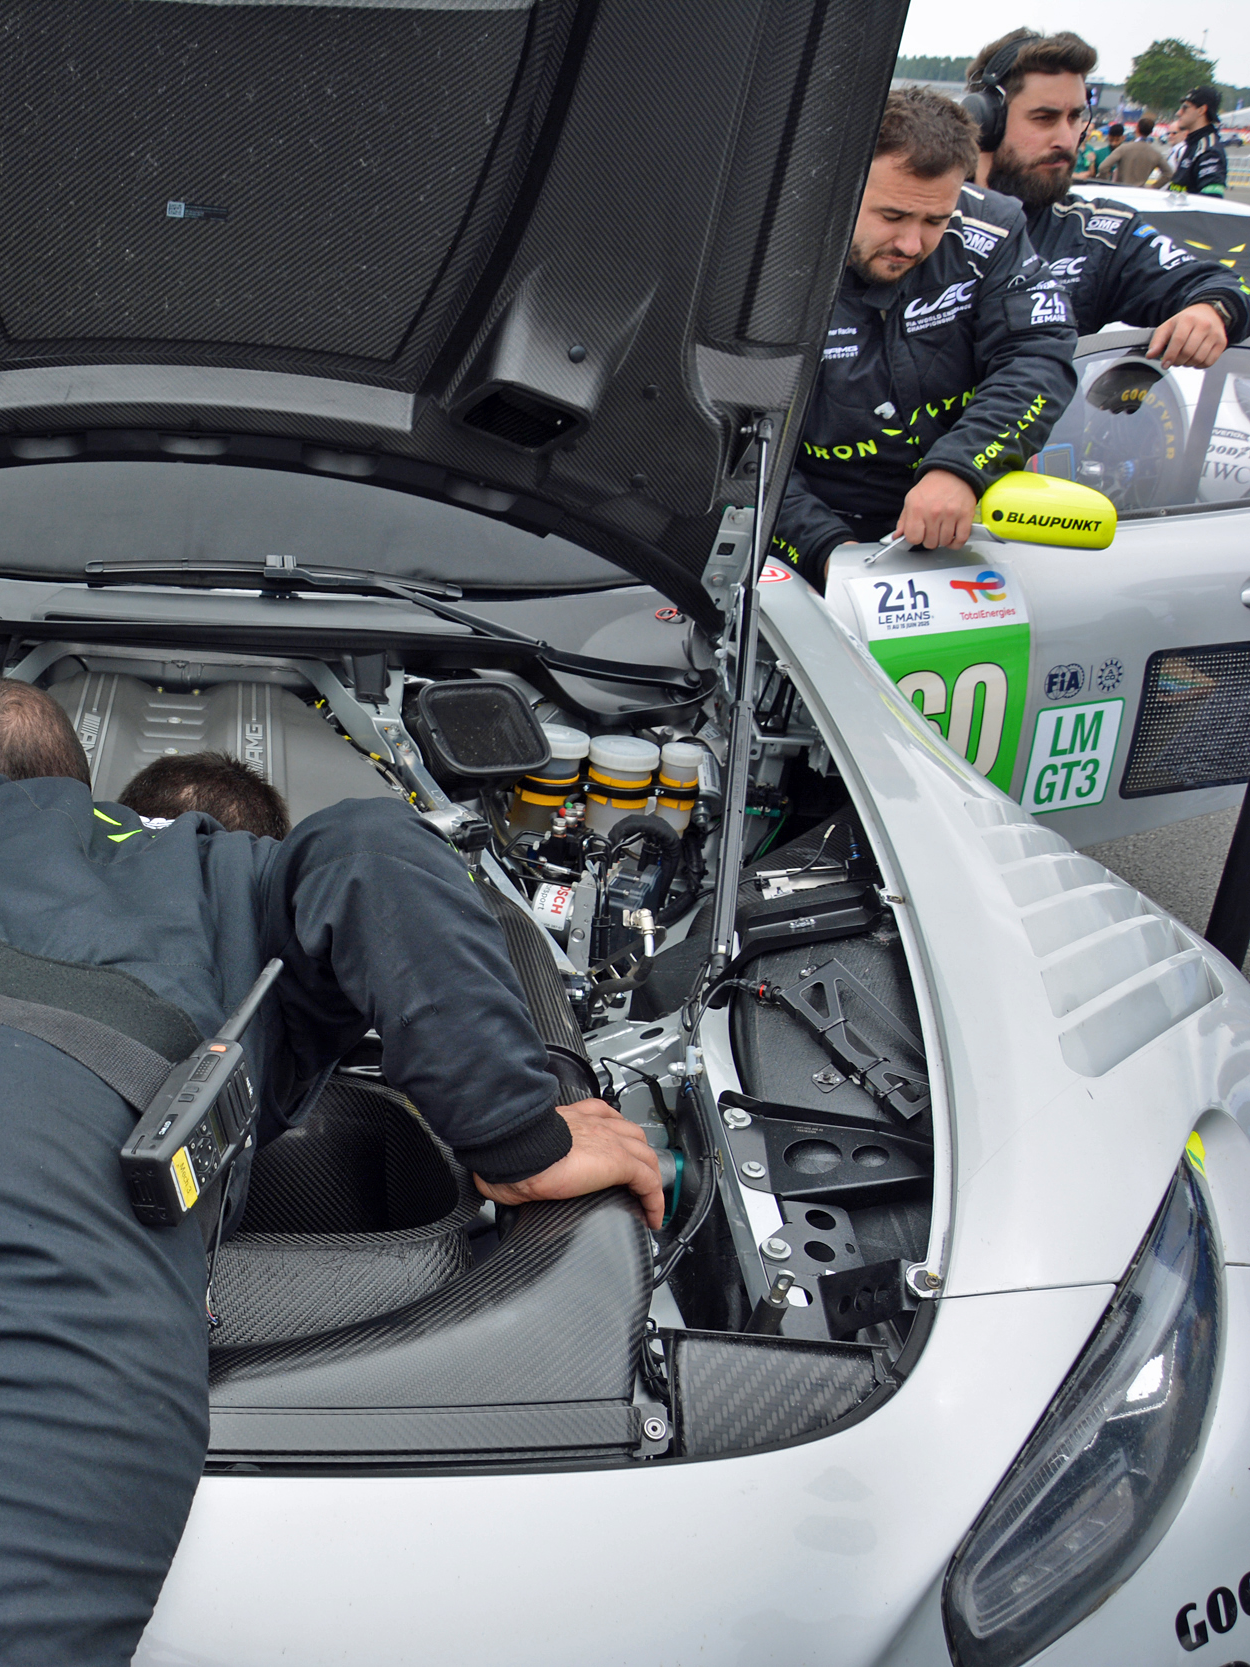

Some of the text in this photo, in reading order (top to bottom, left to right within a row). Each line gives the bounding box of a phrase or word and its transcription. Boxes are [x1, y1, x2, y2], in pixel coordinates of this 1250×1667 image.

[1088, 219, 1121, 231] OMP
[1042, 256, 1087, 275] EC
[904, 279, 977, 319] WEC
[1031, 316, 1044, 325] LE
[803, 386, 976, 461] IRON LYN
[972, 394, 1047, 470] IRON LYNX
[1006, 512, 1101, 533] BLAUPUNKT
[772, 535, 799, 564] LYNX
[873, 578, 929, 614] 24h
[878, 611, 931, 626] LE MANS
[959, 607, 1016, 622] TotalEnergies
[1049, 710, 1105, 757] LM
[1033, 758, 1100, 805] GT3
[551, 885, 572, 915] OSCH
